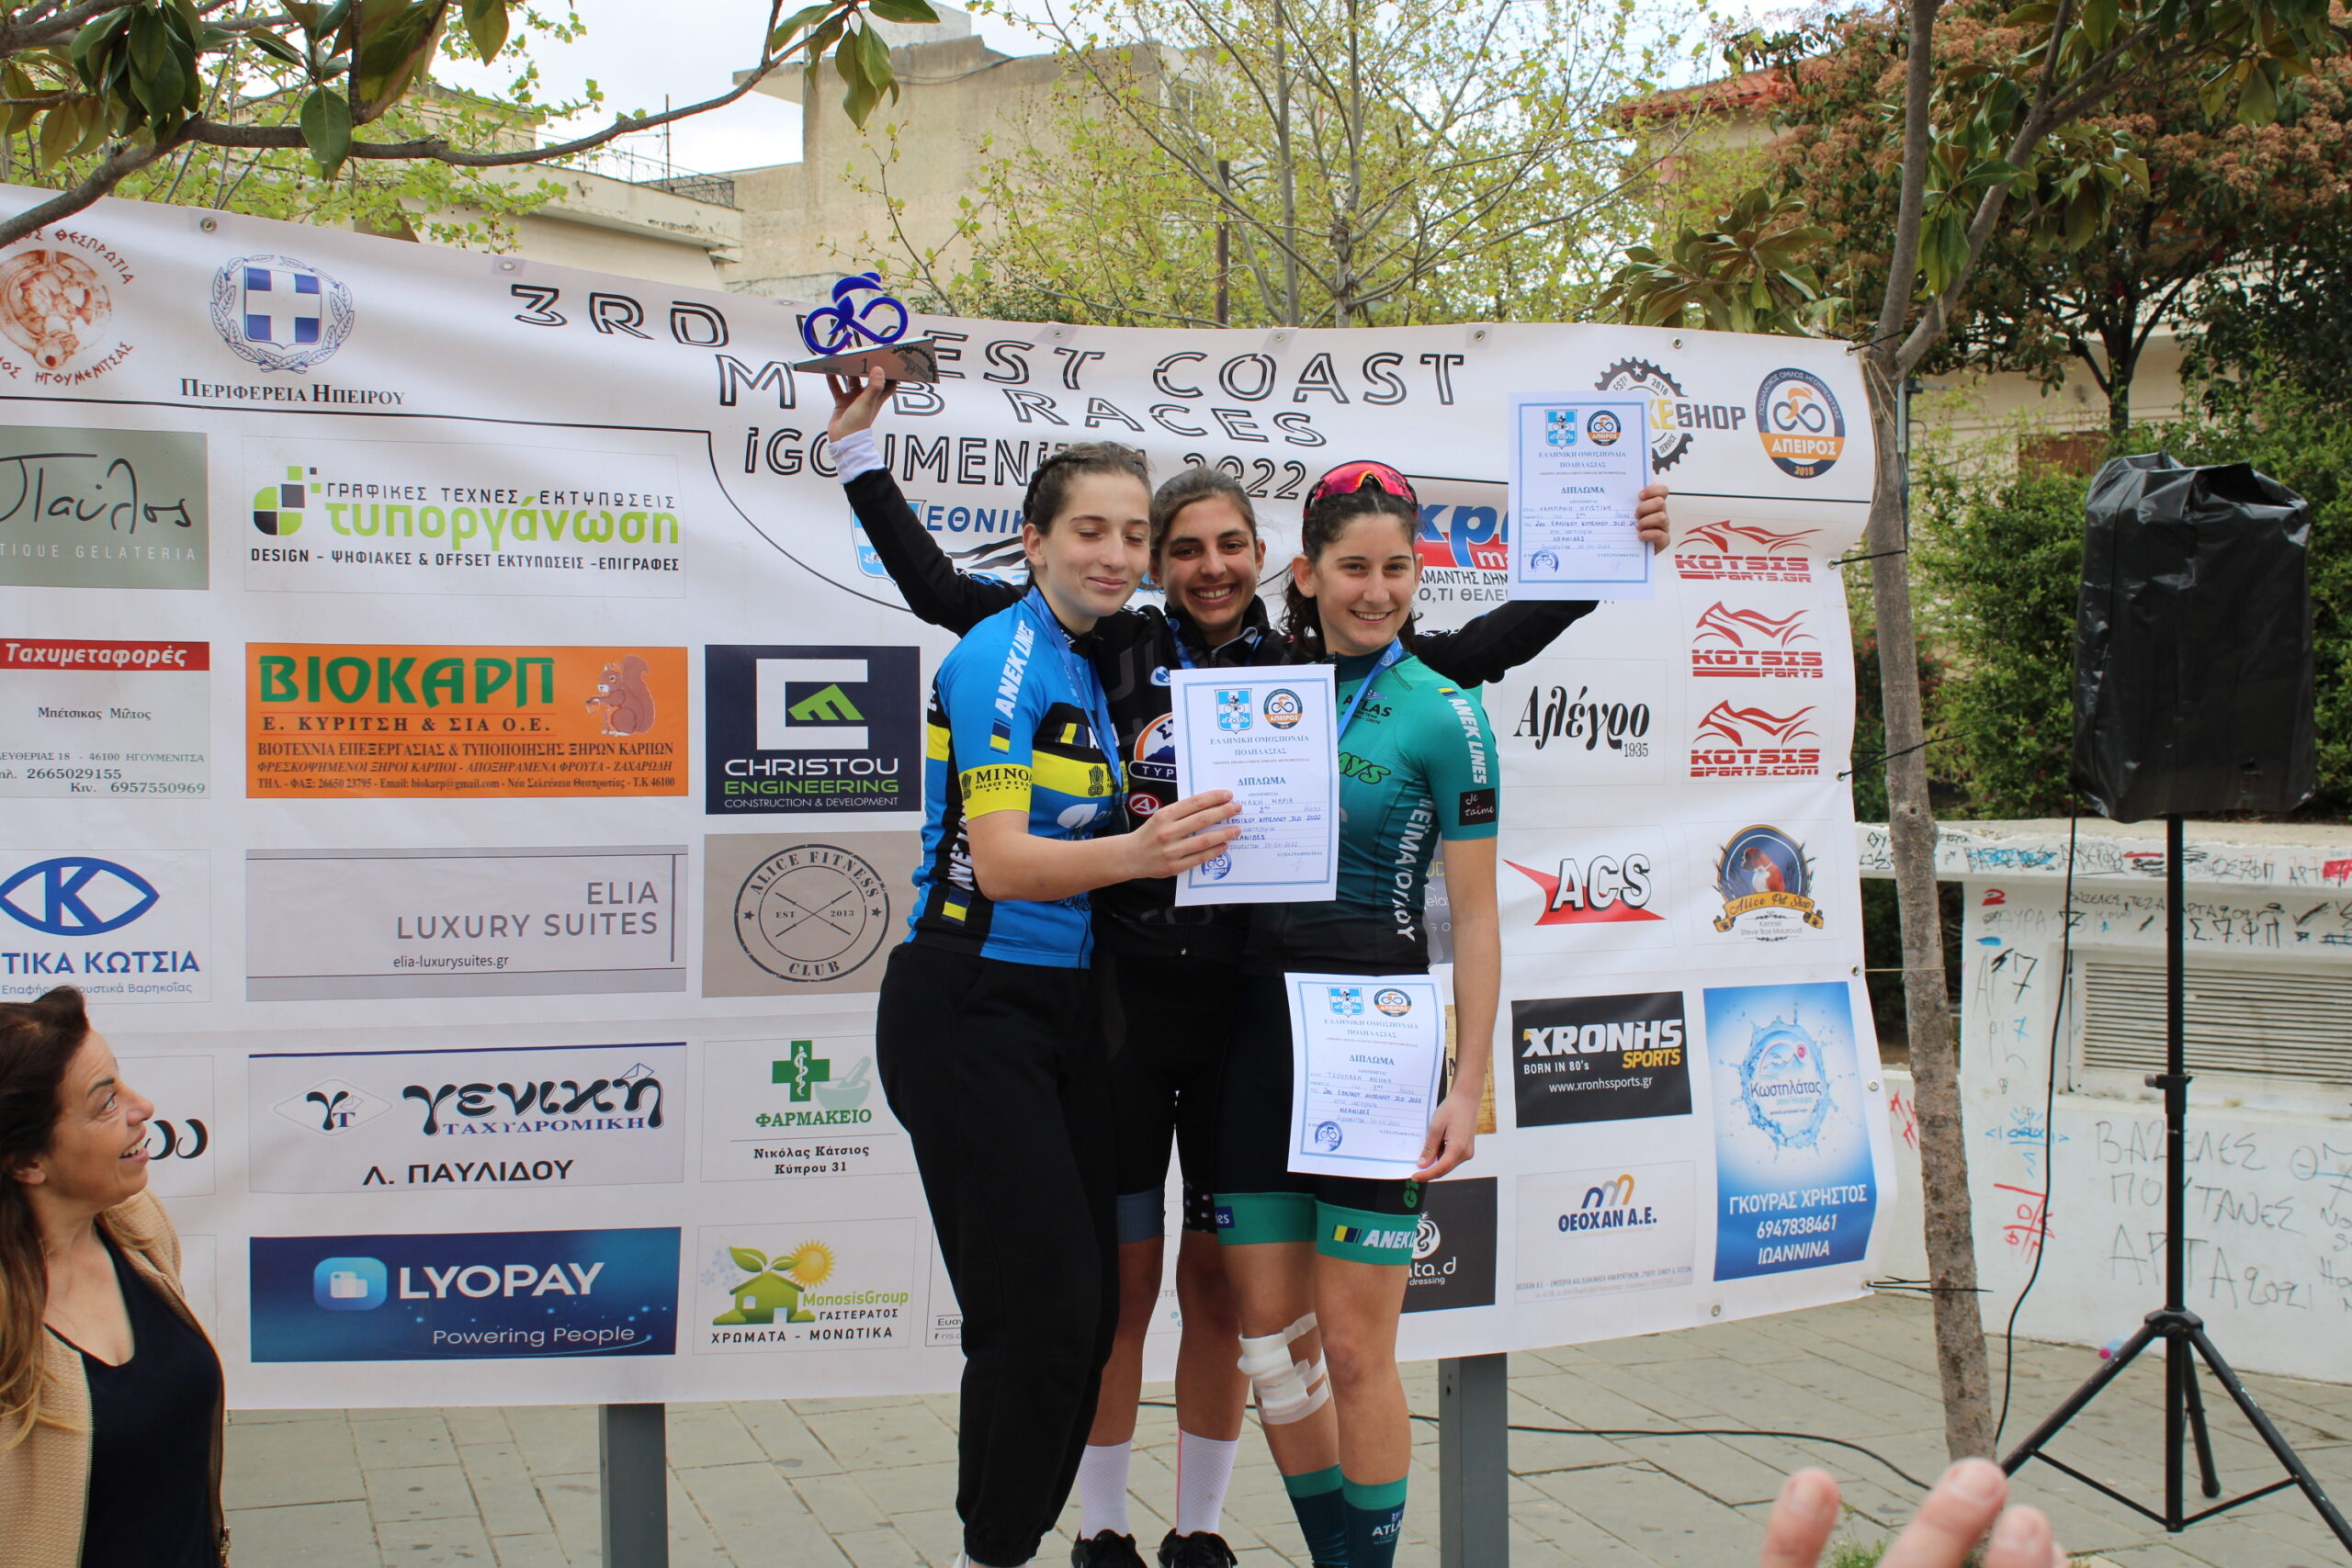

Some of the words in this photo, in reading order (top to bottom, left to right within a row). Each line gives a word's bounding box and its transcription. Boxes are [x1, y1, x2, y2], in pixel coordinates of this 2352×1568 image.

[511, 284, 729, 348] 3RD
[1153, 351, 1464, 406] COAST
[180, 378, 307, 403] ΠΕΡΙΦΕΡΕΙΑ
[312, 383, 405, 406] ΗΠΕΙΡΟΥ
[1002, 389, 1327, 447] RACES
[1771, 438, 1836, 456] ΑΠΕΙΡΟΣ
[327, 482, 426, 502] ΓΡΑΦΙΚΕΣ
[441, 486, 517, 504] ΤΕΧΝΕΣ
[540, 491, 675, 509] ΕΚΤΥΠΩΣΕΙΣ
[1561, 486, 1605, 494] ΔΙΠΛΩΜΑ
[324, 496, 678, 551] τυποργάνωση
[76, 546, 196, 560] GELATERIA
[251, 548, 310, 563] DESIGN
[332, 549, 412, 566] ΨΗΦΙΑΚΕΣ
[419, 553, 429, 566] &
[435, 553, 490, 567] OFFSET
[498, 554, 584, 570] ΕΚΤΥΠΩΣΕΙΣ
[1675, 555, 1810, 571] KOTSIS
[6, 642, 187, 668] Ταχυμεταφορές
[1691, 649, 1823, 666] KOTSIS
[258, 655, 556, 709] ΒΙΟΚΑΡΠ
[994, 649, 1028, 719] ANEK
[38, 707, 103, 720] Μπέτσικας
[263, 717, 285, 732] Ε.
[298, 716, 408, 732] ΚΥΡΙΤΣΗ
[422, 717, 436, 732] &
[449, 717, 490, 732] ΣΙΑ
[503, 717, 550, 732] Ο.Ε.
[257, 742, 334, 756] ΒΙΟΤΕΧΝΙΑ
[339, 743, 445, 756] ΕΠΕΞΕΡΓΑΣΙΑΣ
[448, 743, 458, 756] &
[462, 743, 565, 756] ΤΥΠΟΠΟΙΗΣΗΣ
[569, 743, 615, 756] ΞΗΡΩΝ
[619, 742, 673, 755] ΚΑΡΠΩΝ
[1210, 736, 1253, 745] ΕΛΛΗΝΙΚΗ
[1448, 698, 1480, 744] ANEK
[1468, 740, 1487, 784] LINES
[59, 752, 71, 761] 18
[89, 753, 120, 761] 46100
[126, 754, 205, 762] ΗΓΟΥΜΕΝΙΤΣΑ
[1623, 743, 1649, 758] 1935
[1690, 749, 1820, 765] KOTSIS
[27, 768, 122, 780] 2665029155
[725, 757, 899, 776] CHRISTOU
[110, 783, 206, 794] 6957550969
[725, 780, 899, 795] ENGINEERING
[1238, 776, 1286, 786] ΔΙΠΛΩΜΑ
[725, 797, 813, 808] CONSTRUCTION
[815, 798, 823, 807] &
[826, 796, 899, 807] DEVELOPMENT
[751, 853, 800, 896] ALICE
[809, 852, 879, 898] FITNESS
[1549, 852, 1652, 912] ACS
[587, 881, 659, 905] ELIA
[776, 911, 796, 919] EST
[831, 909, 854, 918] 2013
[397, 915, 530, 940] LUXURY
[544, 911, 658, 937] SUITES
[85, 950, 200, 974] ΚΩΤΣΙΑ
[393, 954, 509, 970] elia-luxurysuites.gr
[788, 960, 841, 977] CLUB
[1521, 1019, 1682, 1057] XRONHS
[1349, 1055, 1395, 1066] ΔΙΠΛΩΜΑ
[1523, 1062, 1552, 1075] BORN
[1555, 1062, 1566, 1073] IN
[1569, 1060, 1589, 1072] 80's
[1623, 1049, 1680, 1069] SPORTS
[1549, 1075, 1653, 1093] www.xronhssports.gr
[1750, 1079, 1822, 1098] Κωστηλάτας
[443, 1117, 646, 1135] ΤΑΧΥΔΡΟΜΙΚΗ
[755, 1109, 872, 1128] ΦΑΡΜΑΚΕΙΟ
[753, 1146, 810, 1159] Νικόλας
[815, 1145, 869, 1157] Κάτσιος
[363, 1166, 394, 1186] Λ.
[408, 1160, 574, 1185] ΠΑΥΛΙΔΟΥ
[775, 1162, 826, 1176] Κύπρου
[831, 1161, 847, 1172] 31
[1730, 1190, 1797, 1215] ΓΚΟΥΡΑΣ
[1801, 1184, 1868, 1209] ΧΡΗΣΤΟΣ
[1558, 1208, 1625, 1232] ΘΕΟΧΑΝ
[1628, 1206, 1657, 1227] Α.Ε.
[1757, 1213, 1838, 1239] 6947838461
[1758, 1240, 1830, 1266] ΙΩΑΝΝΙΝΑ
[399, 1262, 605, 1300] LYOPAY
[1409, 1277, 1445, 1286] dressing
[802, 1291, 909, 1309] MonosisGroup
[820, 1309, 899, 1321] ΓΑΣΤΕΡΑΤΟΣ
[433, 1326, 546, 1348] Powering
[553, 1325, 635, 1347] People
[711, 1331, 786, 1344] ΧΡΩΜΑΤΑ
[809, 1327, 892, 1340] ΜΟΝΩΤΙΚΑ
